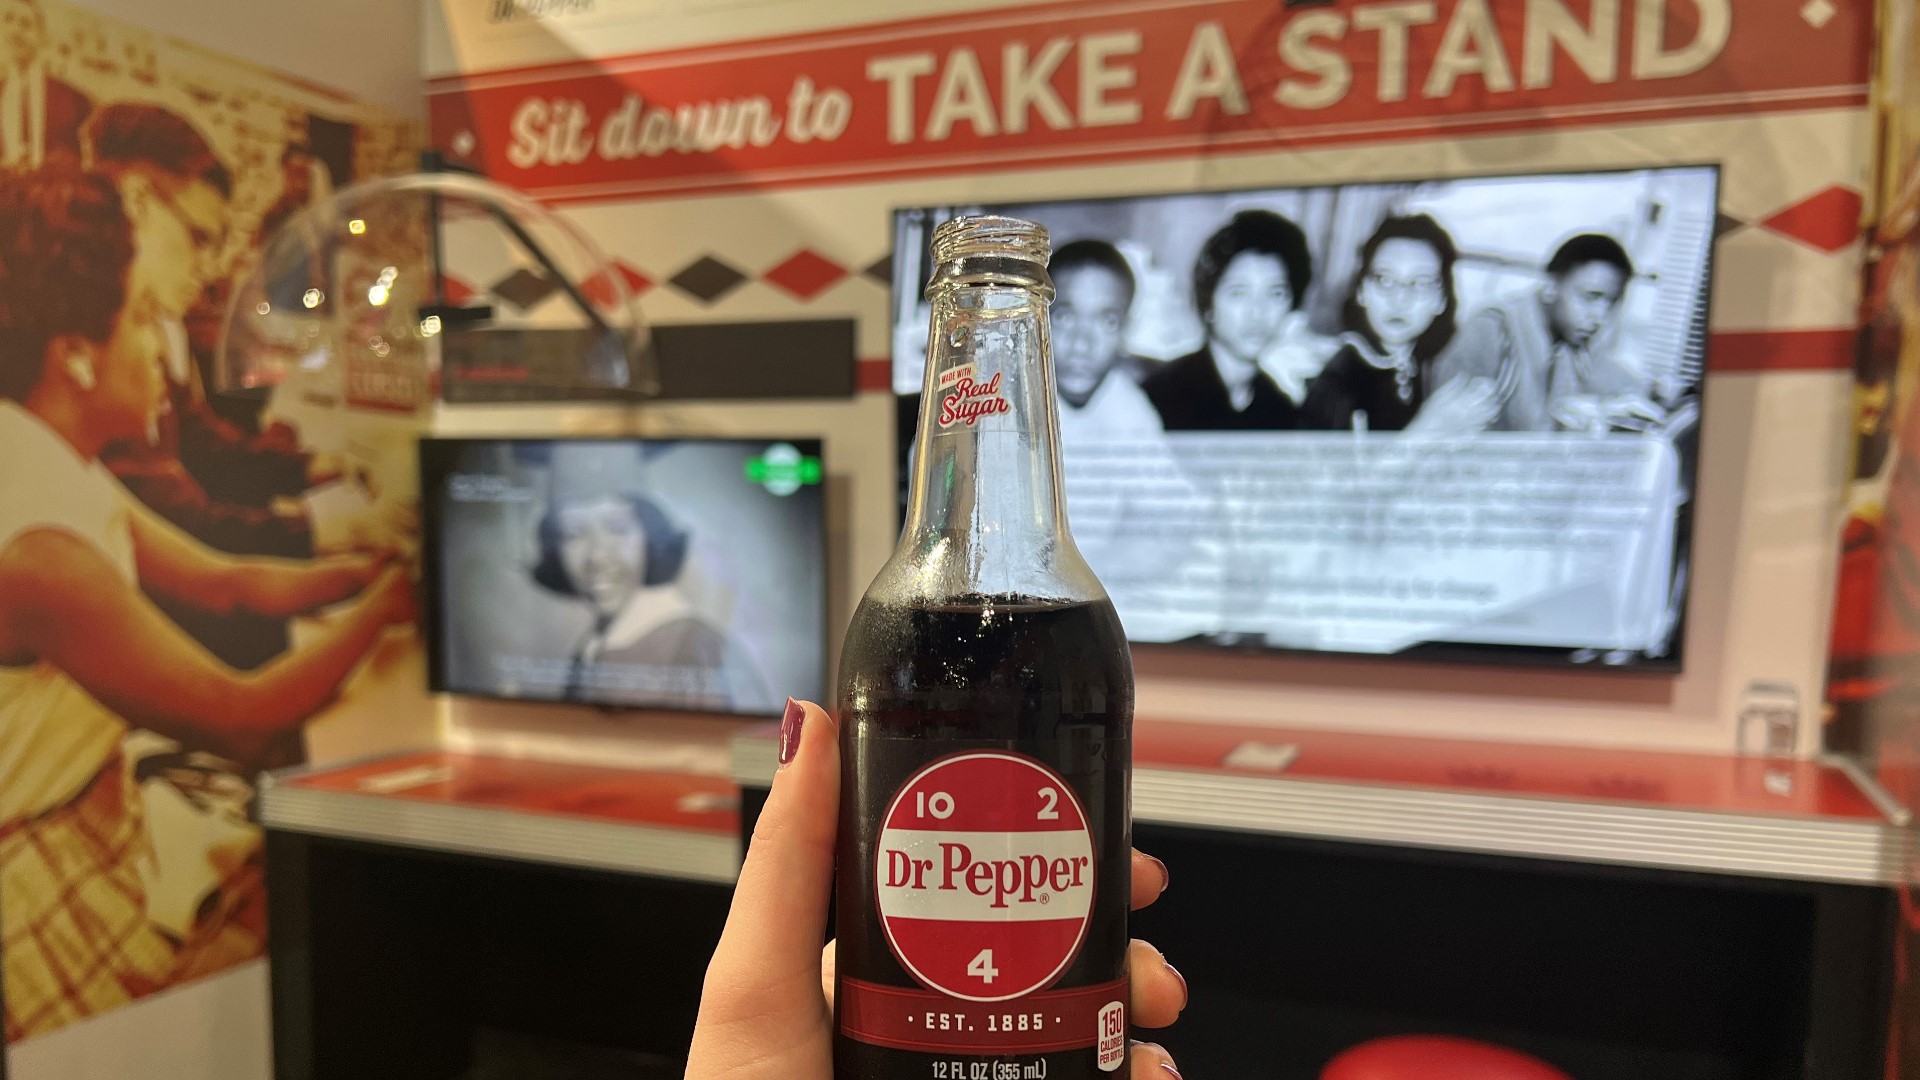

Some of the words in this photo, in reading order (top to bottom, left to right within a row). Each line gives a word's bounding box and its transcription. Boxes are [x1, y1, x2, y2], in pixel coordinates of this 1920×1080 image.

[507, 97, 594, 168] Sit
[596, 93, 782, 161] down
[783, 74, 854, 141] to
[866, 30, 1143, 144] TAKE
[1165, 23, 1249, 120] A
[1275, 0, 1732, 110] STAND
[942, 372, 955, 384] MADE
[956, 367, 971, 379] WITH
[955, 372, 1001, 400] Real
[939, 396, 1008, 425] Sugar
[916, 791, 954, 818] 10
[1037, 787, 1059, 820] 2
[885, 849, 933, 889] Dr
[938, 842, 1088, 908] Pepper
[967, 949, 999, 983] 4
[926, 1012, 974, 1031] EST.
[988, 1013, 1043, 1031] 1885
[1103, 1007, 1122, 1038] 150
[1100, 1053, 1109, 1064] PER
[1110, 1048, 1123, 1061] BOTTLE
[1101, 1035, 1122, 1052] CALORIES
[932, 1061, 947, 1079] 12
[951, 1061, 966, 1080] FL
[970, 1062, 988, 1080] OZ
[992, 1059, 1020, 1080] (355
[1024, 1057, 1047, 1080] mL)
